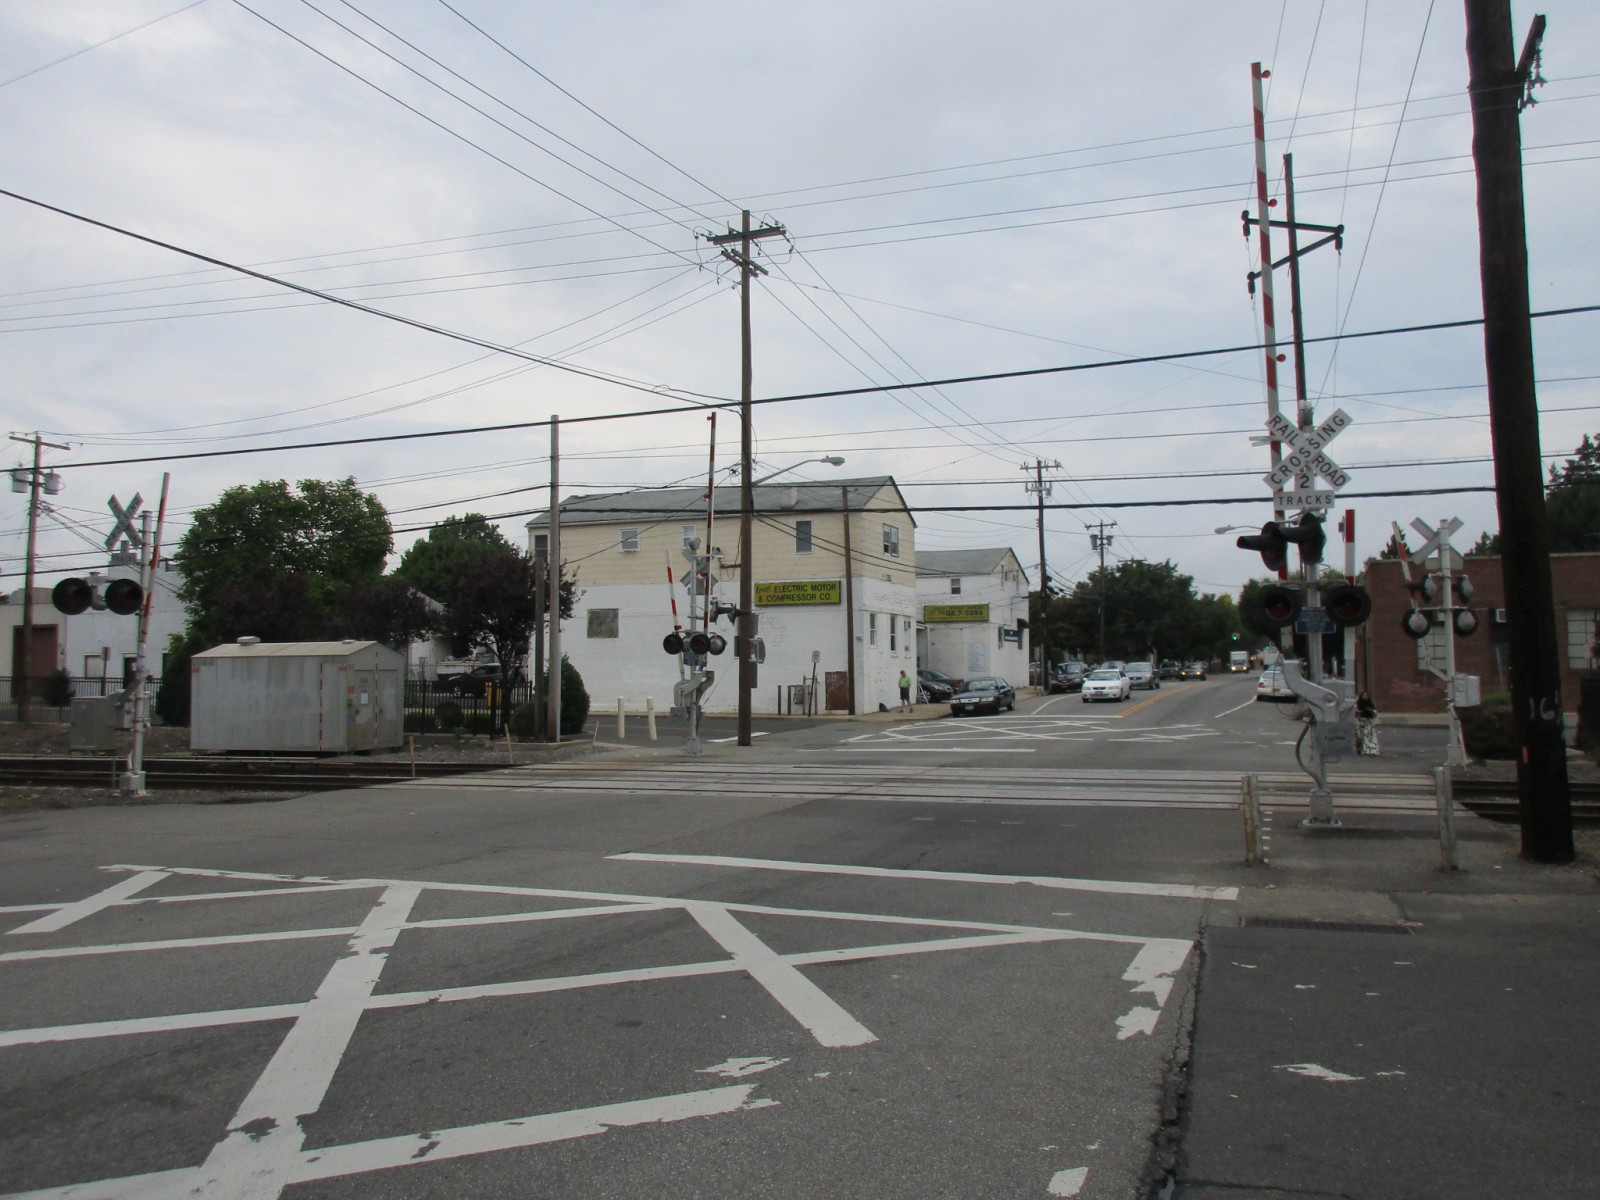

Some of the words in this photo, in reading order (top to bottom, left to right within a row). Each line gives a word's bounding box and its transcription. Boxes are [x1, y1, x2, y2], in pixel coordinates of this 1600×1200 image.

[1270, 415, 1345, 485] CROSSING
[1300, 474, 1310, 489] 2
[1278, 493, 1332, 507] TRACKS
[773, 584, 808, 594] ELECTRIC
[811, 583, 837, 592] MOTOR
[766, 593, 817, 603] COMPRESSOR
